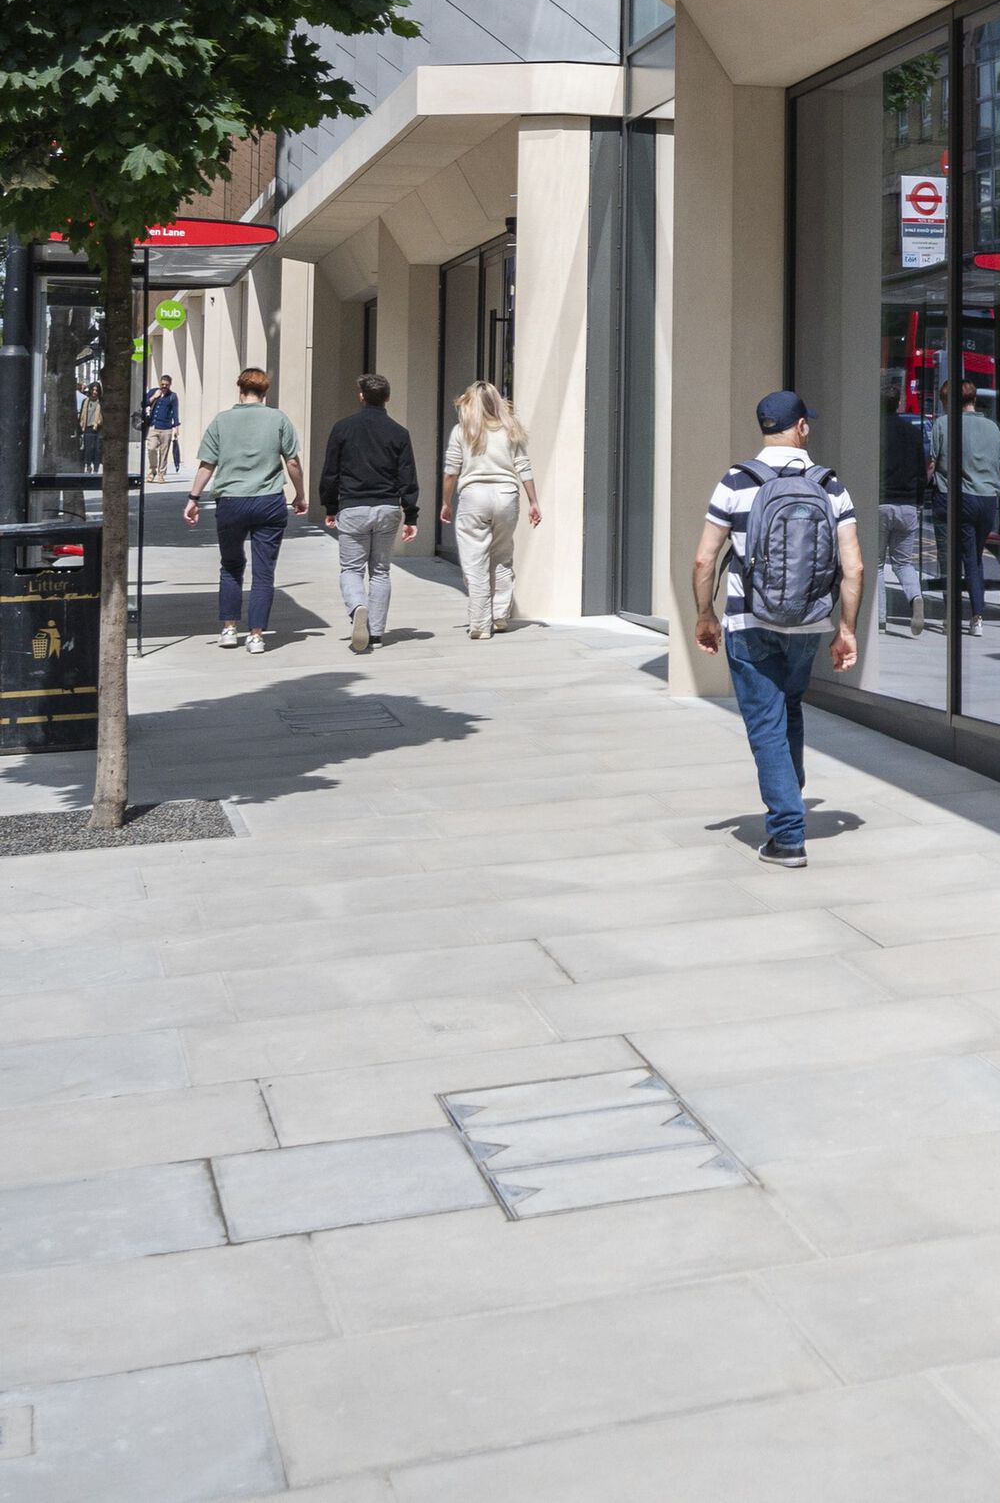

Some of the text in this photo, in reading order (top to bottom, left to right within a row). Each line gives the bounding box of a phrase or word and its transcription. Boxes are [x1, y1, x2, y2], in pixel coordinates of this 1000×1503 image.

[162, 227, 186, 237] Lane
[160, 307, 181, 318] hub
[28, 579, 70, 593] Litter
